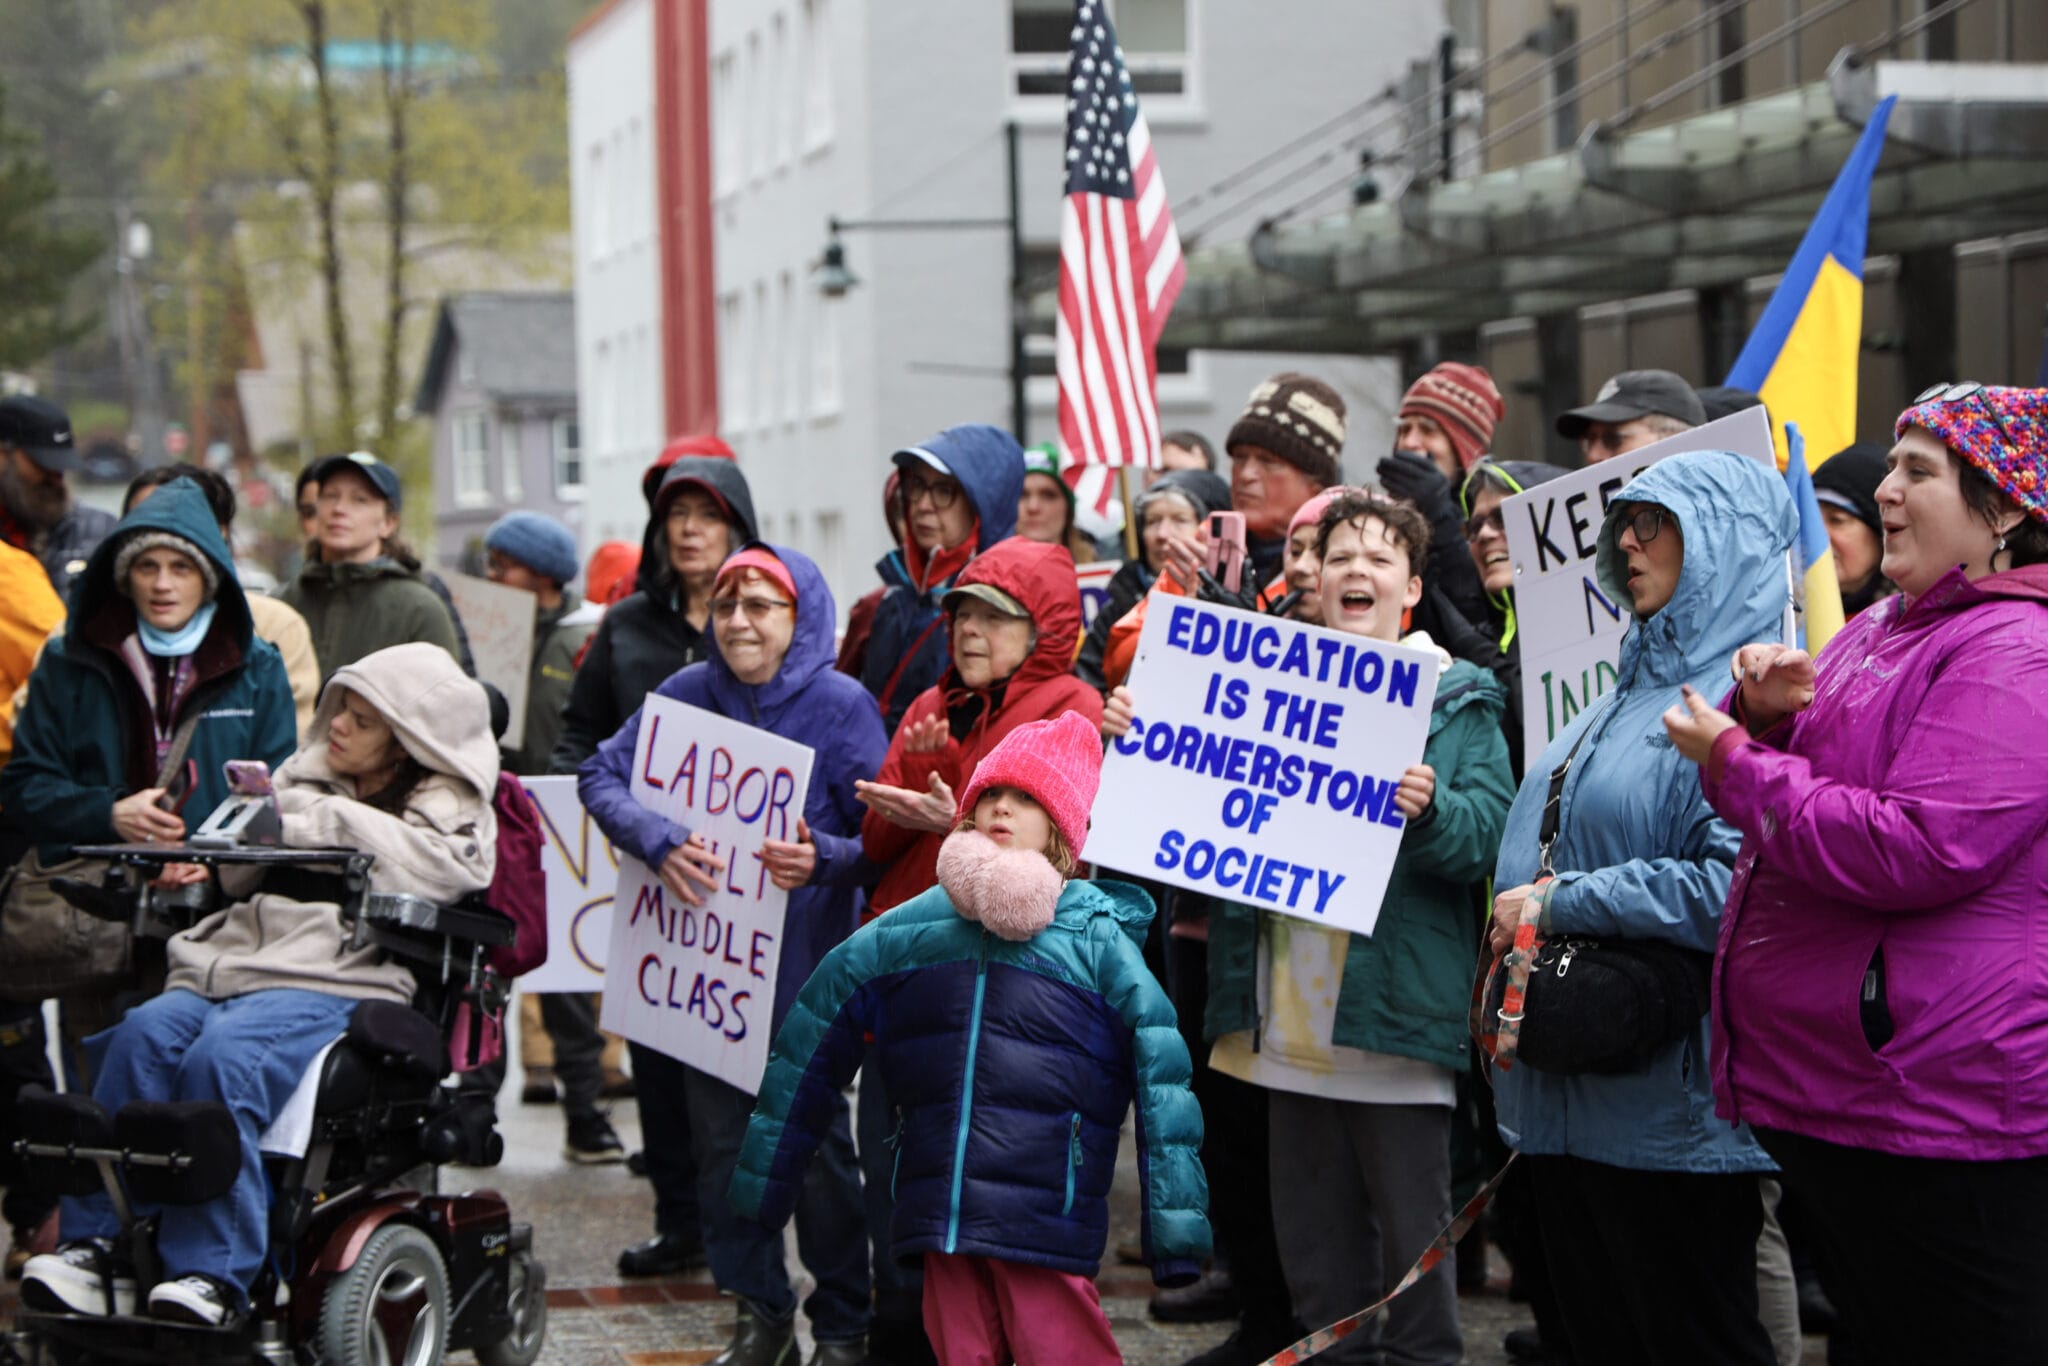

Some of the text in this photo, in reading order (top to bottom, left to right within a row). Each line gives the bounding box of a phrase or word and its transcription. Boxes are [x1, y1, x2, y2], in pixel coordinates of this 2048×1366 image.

[1167, 605, 1420, 707] EDUCATION
[1204, 673, 1344, 749] IS THE
[643, 714, 794, 841] LABOR
[1114, 717, 1405, 829] CORNERSTONE
[1222, 788, 1279, 834] OF
[1155, 830, 1346, 914] SOCIETY
[630, 884, 774, 980] MIDDLE
[638, 953, 751, 1042] CLASS
